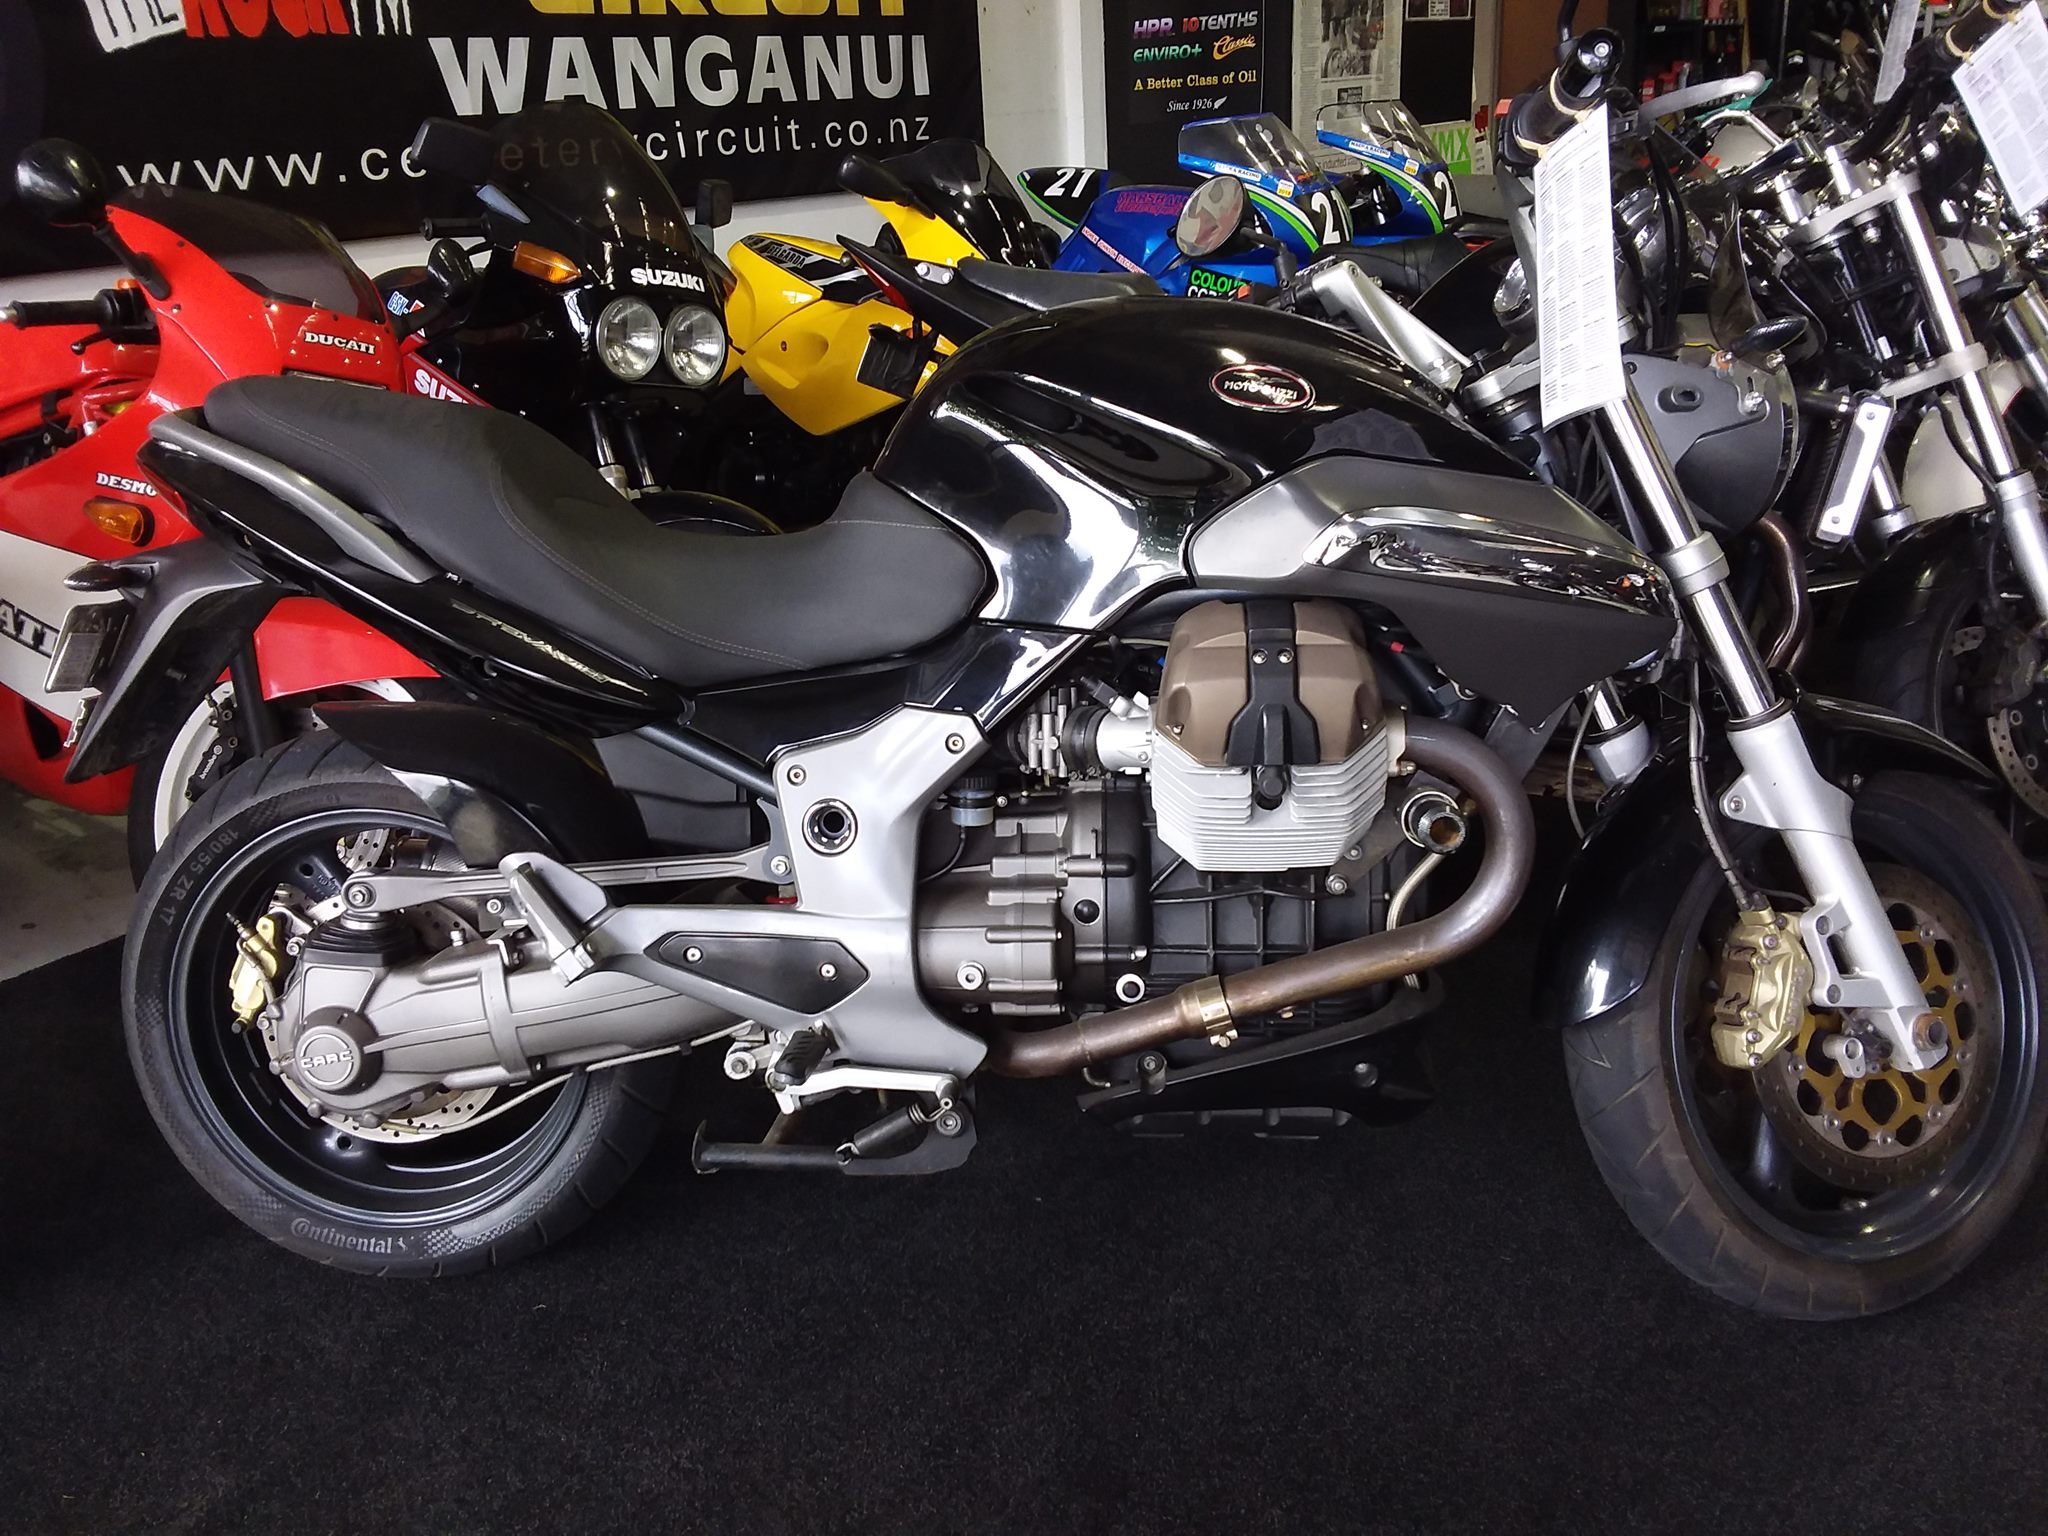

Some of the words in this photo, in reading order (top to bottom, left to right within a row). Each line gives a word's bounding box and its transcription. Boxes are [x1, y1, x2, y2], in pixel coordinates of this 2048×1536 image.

[1133, 18, 1173, 37] HPR
[1133, 43, 1202, 62] ENVIRO+
[1213, 34, 1256, 60] Classic
[428, 35, 930, 116] WANGANUI
[1134, 79, 1143, 91] A
[1147, 76, 1183, 90] Better
[1187, 74, 1218, 87] Class
[1222, 72, 1235, 84] of
[1238, 70, 1257, 83] Oil
[1167, 100, 1190, 112] Since
[1192, 98, 1212, 110] 1926
[1370, 145, 1389, 156] RACING
[1044, 168, 1096, 198] 21
[1238, 169, 1260, 179] RACING
[630, 267, 706, 293] SUZUKI
[304, 331, 376, 355] DUCATI
[96, 472, 158, 497] DESMO
[199, 754, 217, 780] brembo
[190, 829, 240, 874] 180/55
[170, 875, 194, 902] ZR
[159, 906, 177, 926] 17
[300, 1049, 353, 1068] CARC
[290, 1217, 392, 1254] Continental
